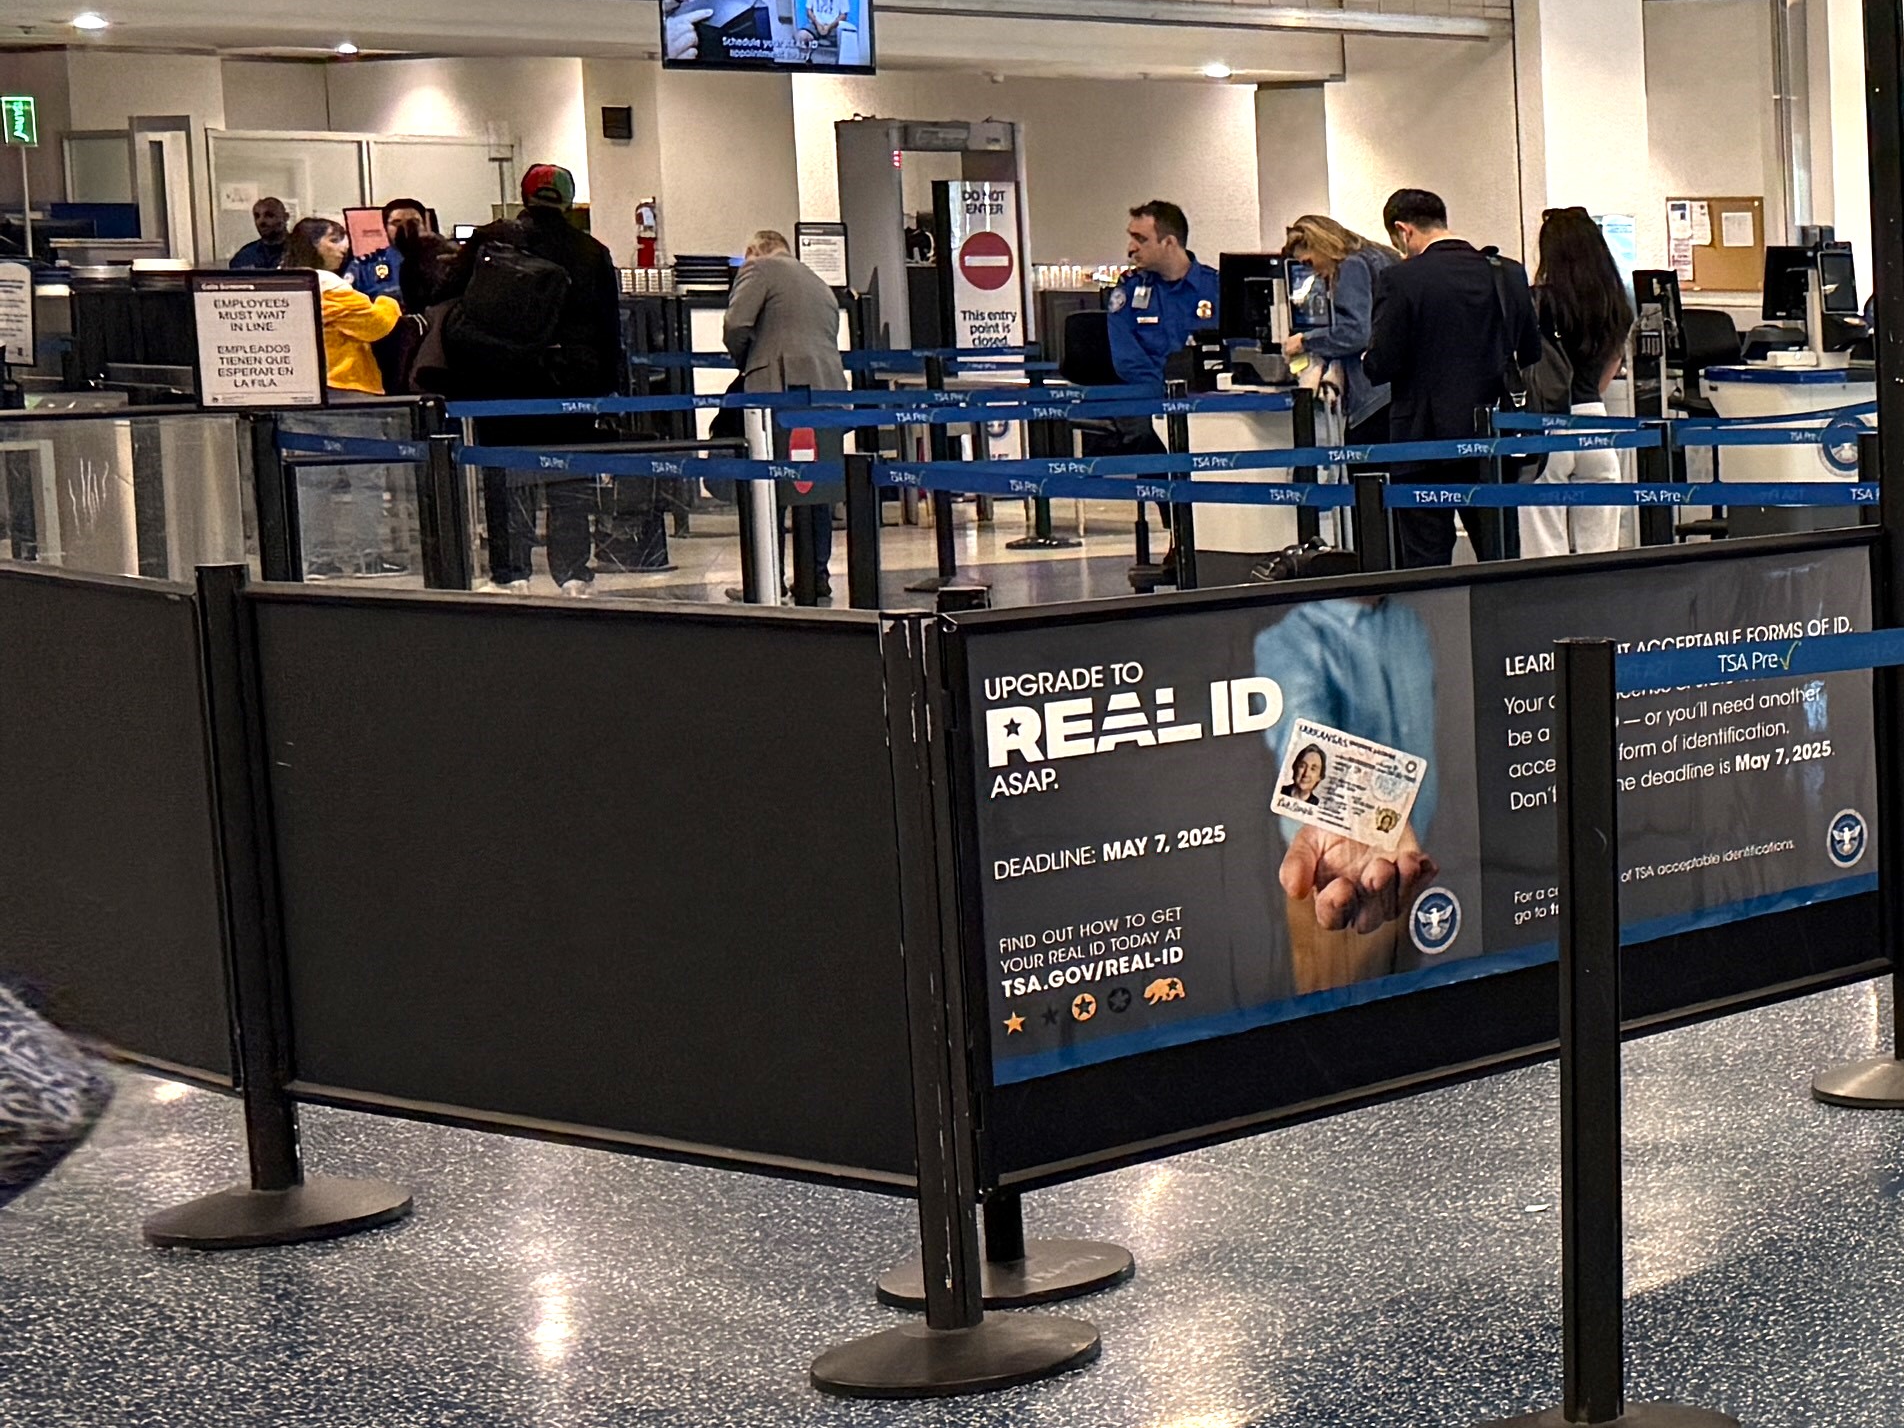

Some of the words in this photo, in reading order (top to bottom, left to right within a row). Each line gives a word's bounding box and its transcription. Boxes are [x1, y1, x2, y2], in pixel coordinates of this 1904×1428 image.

[962, 190, 980, 202] DO
[966, 203, 1003, 215] ENTER
[214, 298, 290, 309] EMPLOYEES
[219, 311, 252, 320] MUST
[256, 310, 286, 320] WAIT
[961, 309, 985, 321] This
[987, 310, 1017, 322] entry
[230, 322, 243, 332] IN
[969, 322, 1000, 336] point
[1002, 322, 1011, 333] is
[217, 344, 291, 354] EMPLEADOS
[219, 356, 262, 366] TIENEN
[265, 356, 291, 365] QUE
[218, 367, 274, 377] ESPERAR
[278, 366, 294, 376] EN
[234, 379, 249, 388] LA
[1048, 463, 1066, 473] TSA
[1412, 490, 1437, 504] TSA
[1440, 491, 1461, 503] Pre
[1633, 490, 1658, 503] TSA
[1660, 489, 1682, 503] Pre
[1850, 488, 1875, 501] TSA
[1747, 622, 1802, 644] FORMS
[1807, 619, 1829, 637] OF
[1833, 616, 1853, 634] ID.
[1718, 653, 1748, 673] TSA
[1752, 651, 1778, 671] Pre
[984, 665, 1104, 700] UPGRADE
[1110, 661, 1144, 685] TO
[1504, 694, 1544, 715] Your
[1644, 710, 1662, 727] or
[1666, 701, 1708, 726] you'll
[1712, 695, 1754, 716] need
[1759, 686, 1820, 709] another
[985, 687, 1203, 768] REAL
[1210, 676, 1283, 737] ID
[1508, 728, 1533, 747] be
[1537, 726, 1550, 742] a
[1619, 742, 1657, 761] form
[1661, 735, 1678, 754] of
[1682, 721, 1790, 750] identification.
[1641, 763, 1715, 788] deadline
[1719, 758, 1731, 774] is
[1735, 753, 1771, 773] May
[1775, 748, 1790, 766] 7,
[1792, 739, 1836, 762] 2025.
[990, 767, 1059, 799] ASAP.
[994, 845, 1096, 881] DEADLINE:
[1103, 836, 1148, 862] MAY
[1154, 834, 1170, 854] 7,
[1177, 824, 1226, 849] 2025
[1621, 869, 1633, 883] of
[1635, 866, 1655, 880] TSA
[1657, 852, 1720, 876] acceptable
[1514, 890, 1533, 904] For
[1535, 889, 1544, 900] a
[1514, 910, 1531, 925] go
[1535, 905, 1547, 918] to
[1000, 934, 1037, 954] FIND
[1042, 926, 1073, 945] OUT
[1079, 918, 1119, 938] HOW
[1126, 913, 1145, 929] TO
[1151, 906, 1183, 924] GET
[1000, 954, 1044, 974] YOUR
[1048, 945, 1085, 965] REAL
[1089, 941, 1105, 956] ID
[1110, 931, 1159, 952] TODAY
[1164, 927, 1183, 942] AT
[1001, 946, 1184, 998] TSA.GOV/REAL-ID
